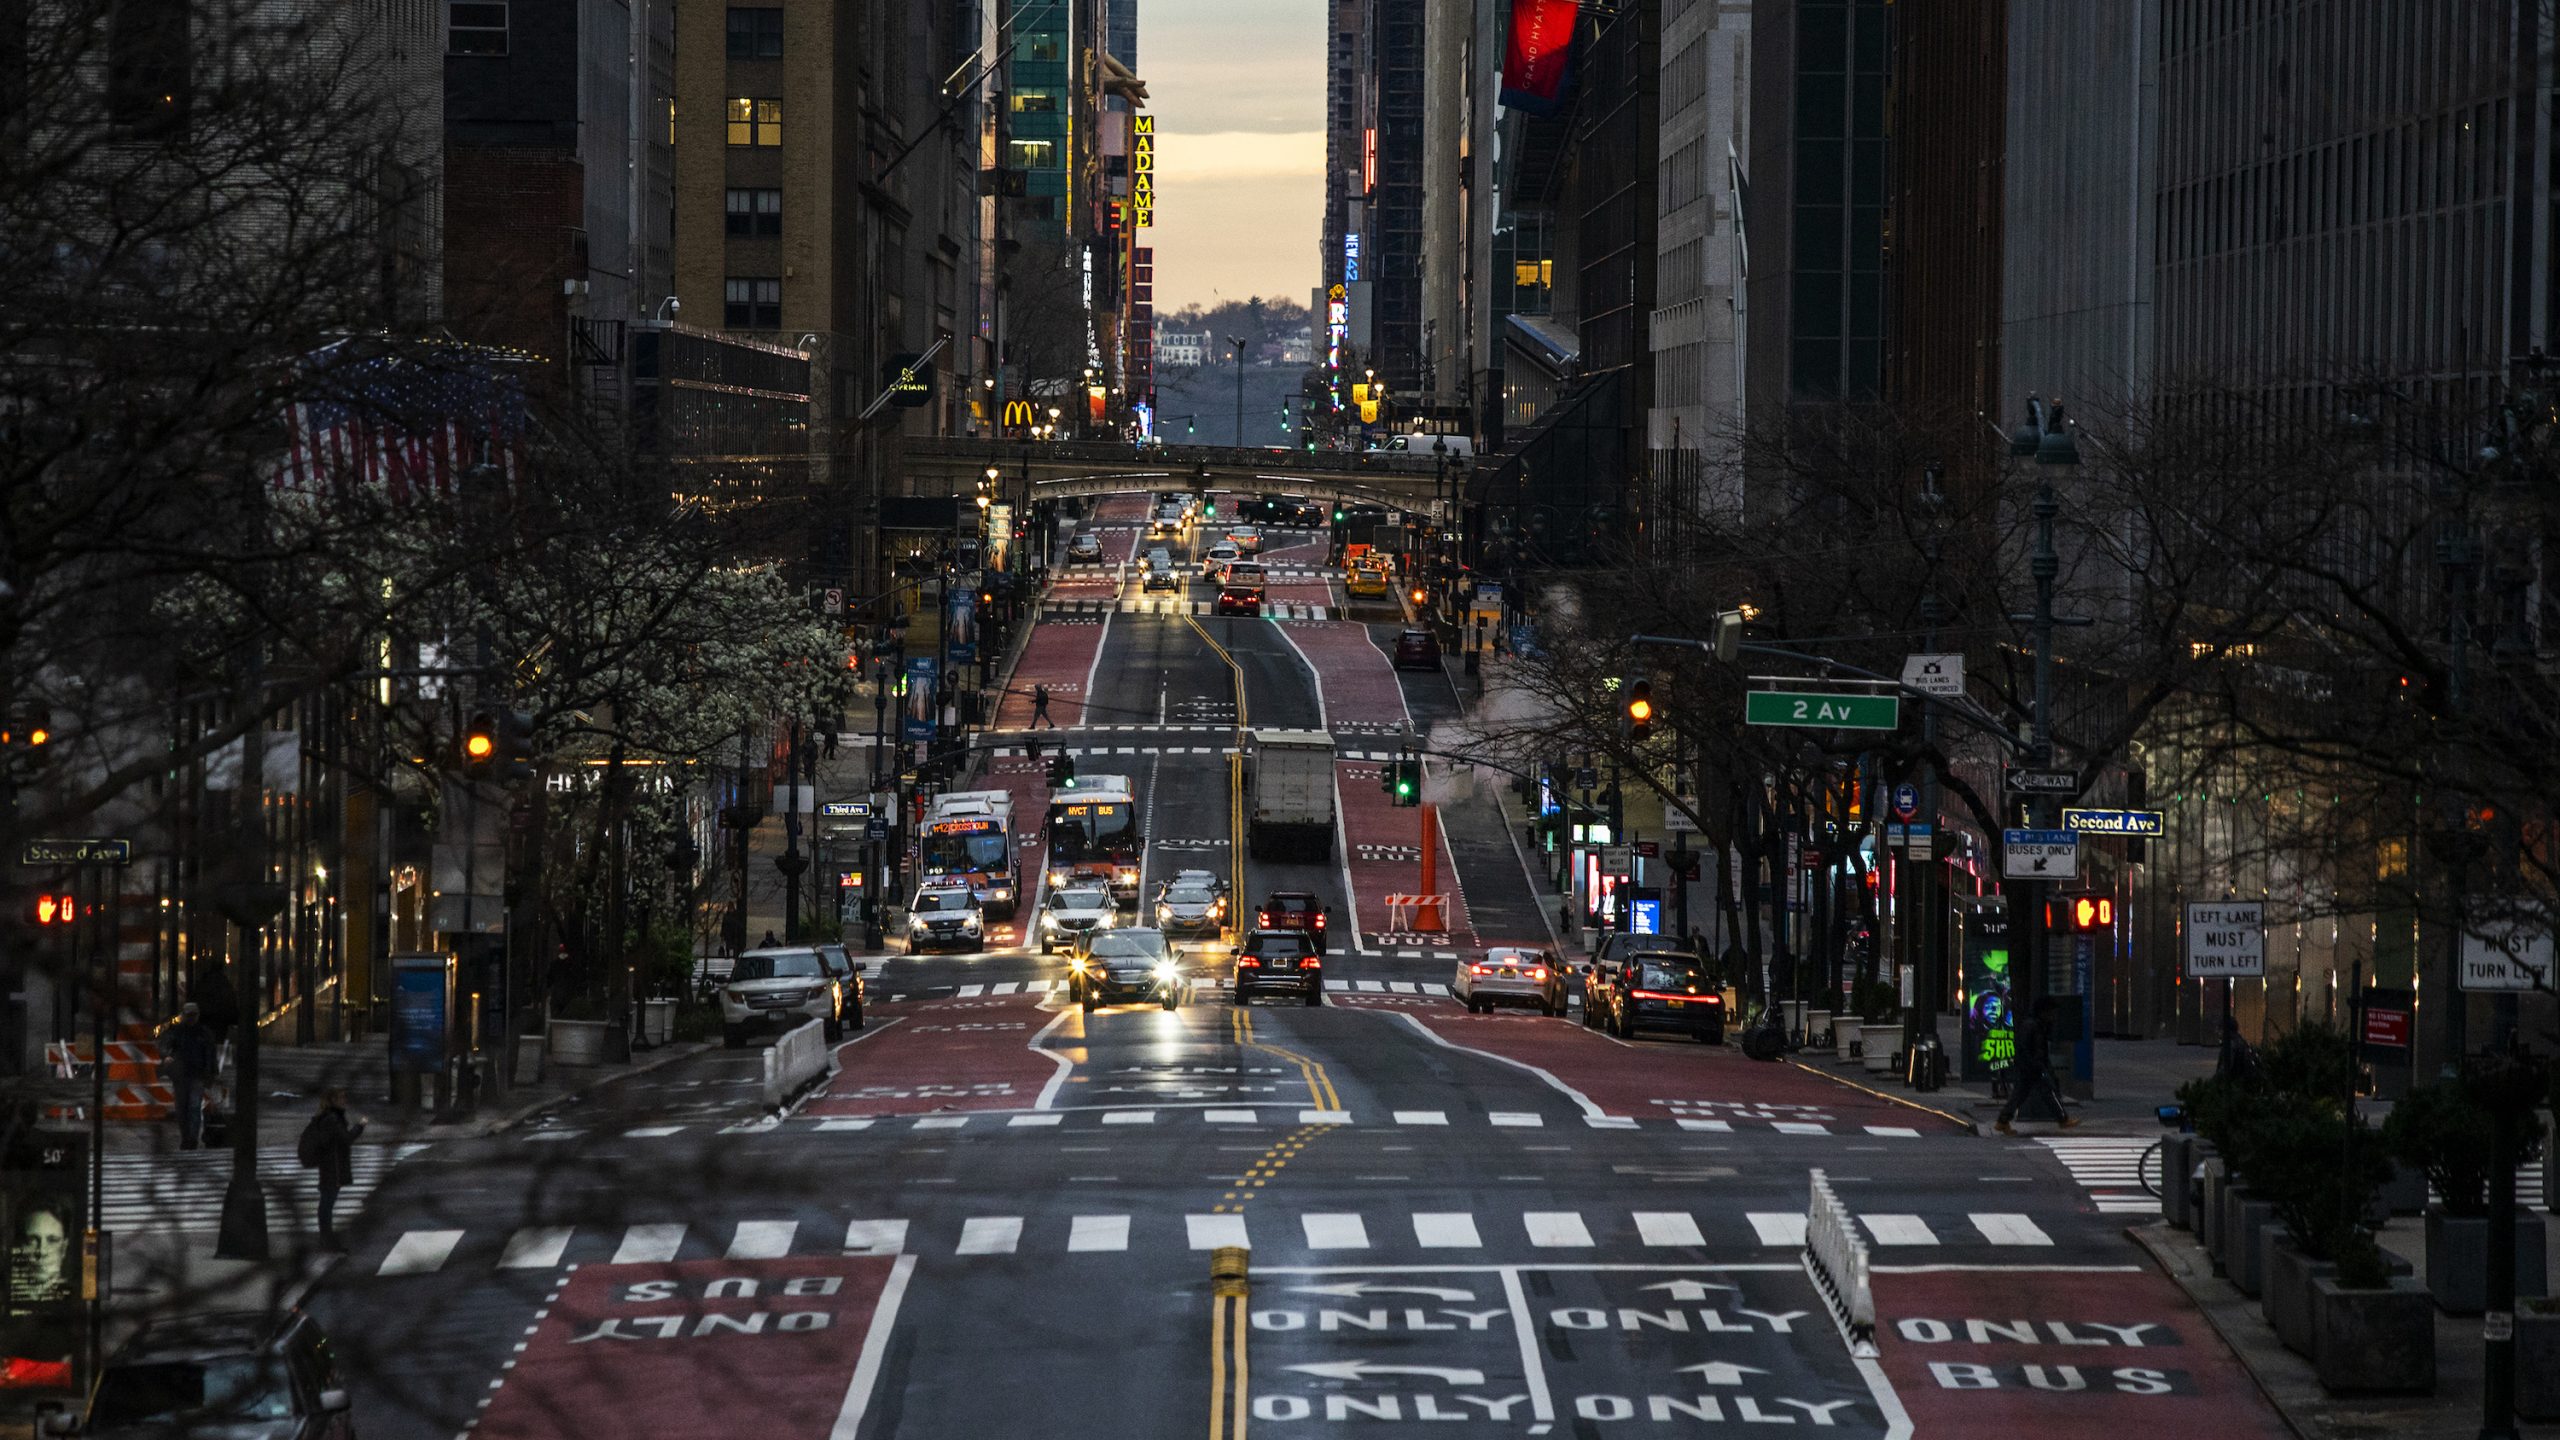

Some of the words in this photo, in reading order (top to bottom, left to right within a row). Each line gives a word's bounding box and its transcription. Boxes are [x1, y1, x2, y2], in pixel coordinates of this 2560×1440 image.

[1522, 46, 1538, 89] GRAND
[1134, 116, 1152, 227] MADAME
[1345, 234, 1358, 258] NEW
[1432, 510, 1442, 520] 25
[1930, 676, 1950, 684] LANES
[1792, 700, 1809, 720] 2
[1816, 701, 1852, 721] Av
[2016, 775, 2035, 786] ONE
[2047, 775, 2070, 786] WAY
[829, 805, 850, 814] Third
[850, 805, 864, 814] Ave
[1068, 806, 1088, 816] NYCT
[1098, 805, 1113, 815] BUS
[2069, 813, 2123, 830] Second
[2126, 816, 2156, 831] Ave
[2046, 831, 2073, 842] LANE
[2008, 845, 2043, 855] BUSES
[2048, 846, 2074, 856] ONLY
[2099, 899, 2111, 924] 0
[2193, 911, 2220, 924] LEFT
[2227, 911, 2257, 923] LANE
[2206, 932, 2245, 947] MUST
[2194, 955, 2224, 968] TURN
[2231, 956, 2258, 968] LEFT
[2469, 963, 2506, 977] TURN
[2513, 965, 2547, 979] LET
[623, 1276, 844, 1301] BUS
[566, 1311, 831, 1344] ONLY
[1250, 1309, 1509, 1331] ONLY
[1550, 1307, 1810, 1333] ONLY
[1896, 1317, 2159, 1347] ONLY
[1926, 1361, 2173, 1395] BUS
[1252, 1394, 1530, 1422] ONLY
[1574, 1395, 1856, 1427] ONLY
